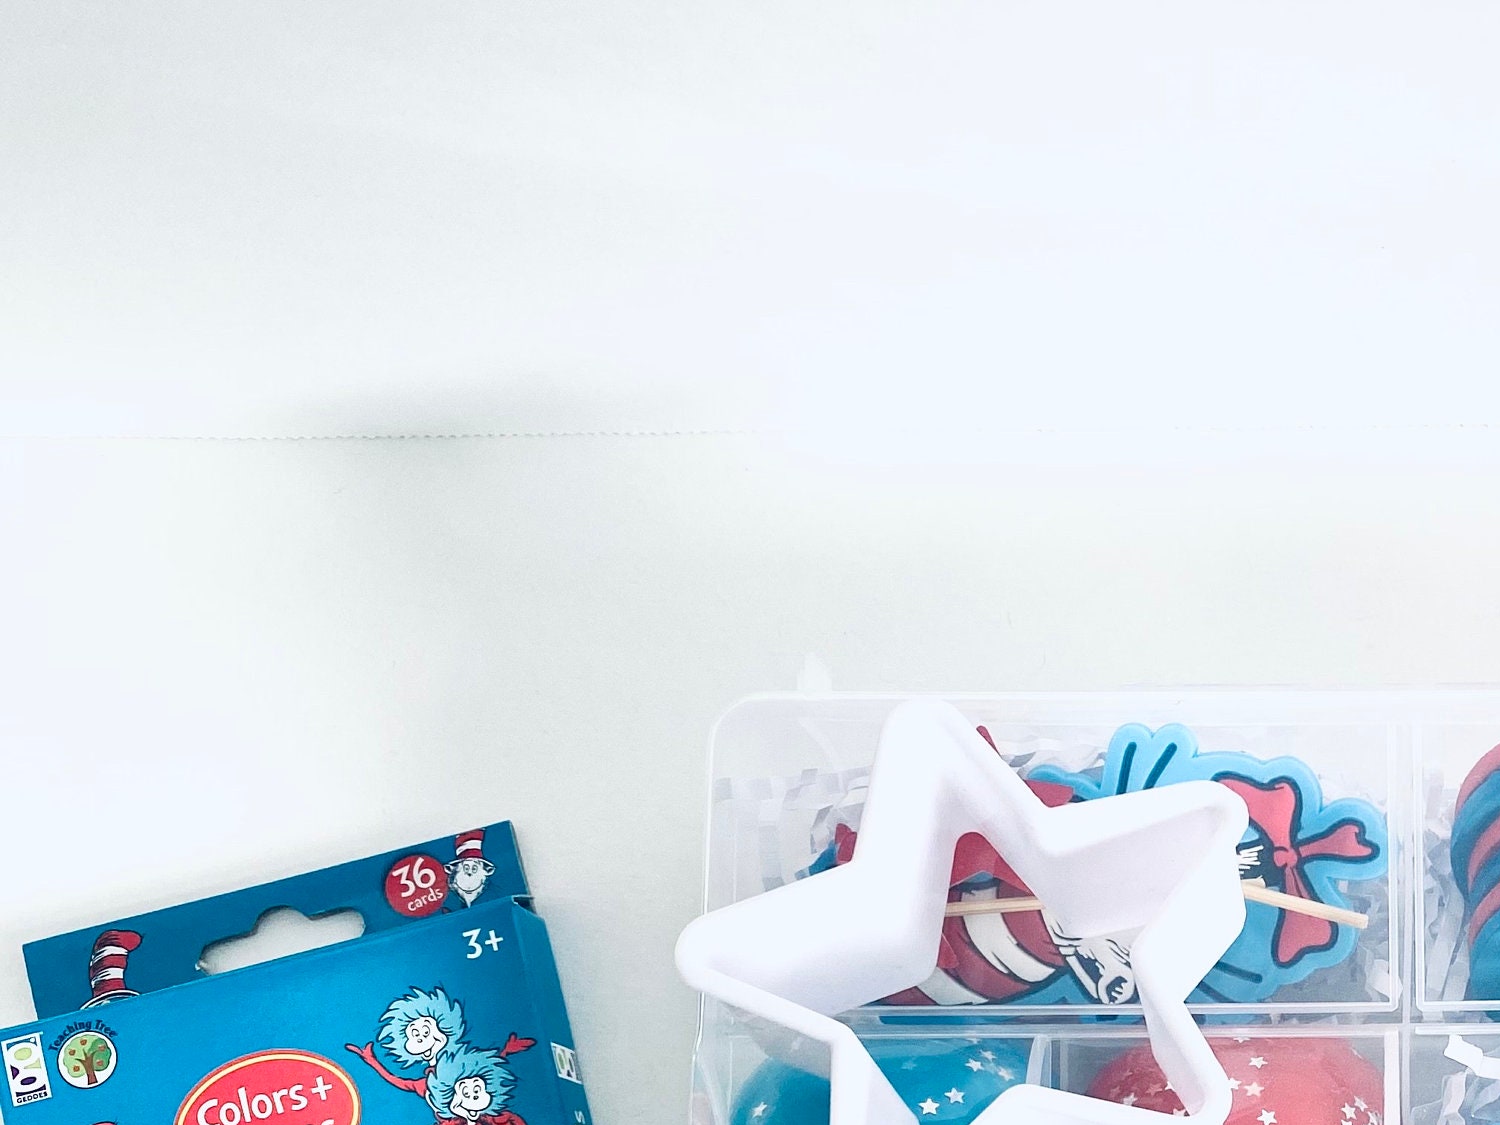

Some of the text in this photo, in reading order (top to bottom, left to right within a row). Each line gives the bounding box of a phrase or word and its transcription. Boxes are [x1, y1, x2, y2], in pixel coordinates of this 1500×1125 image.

[392, 857, 436, 897] 36
[407, 888, 444, 911] cards
[462, 928, 504, 959] 3+
[48, 1020, 118, 1052] Teaching Tree
